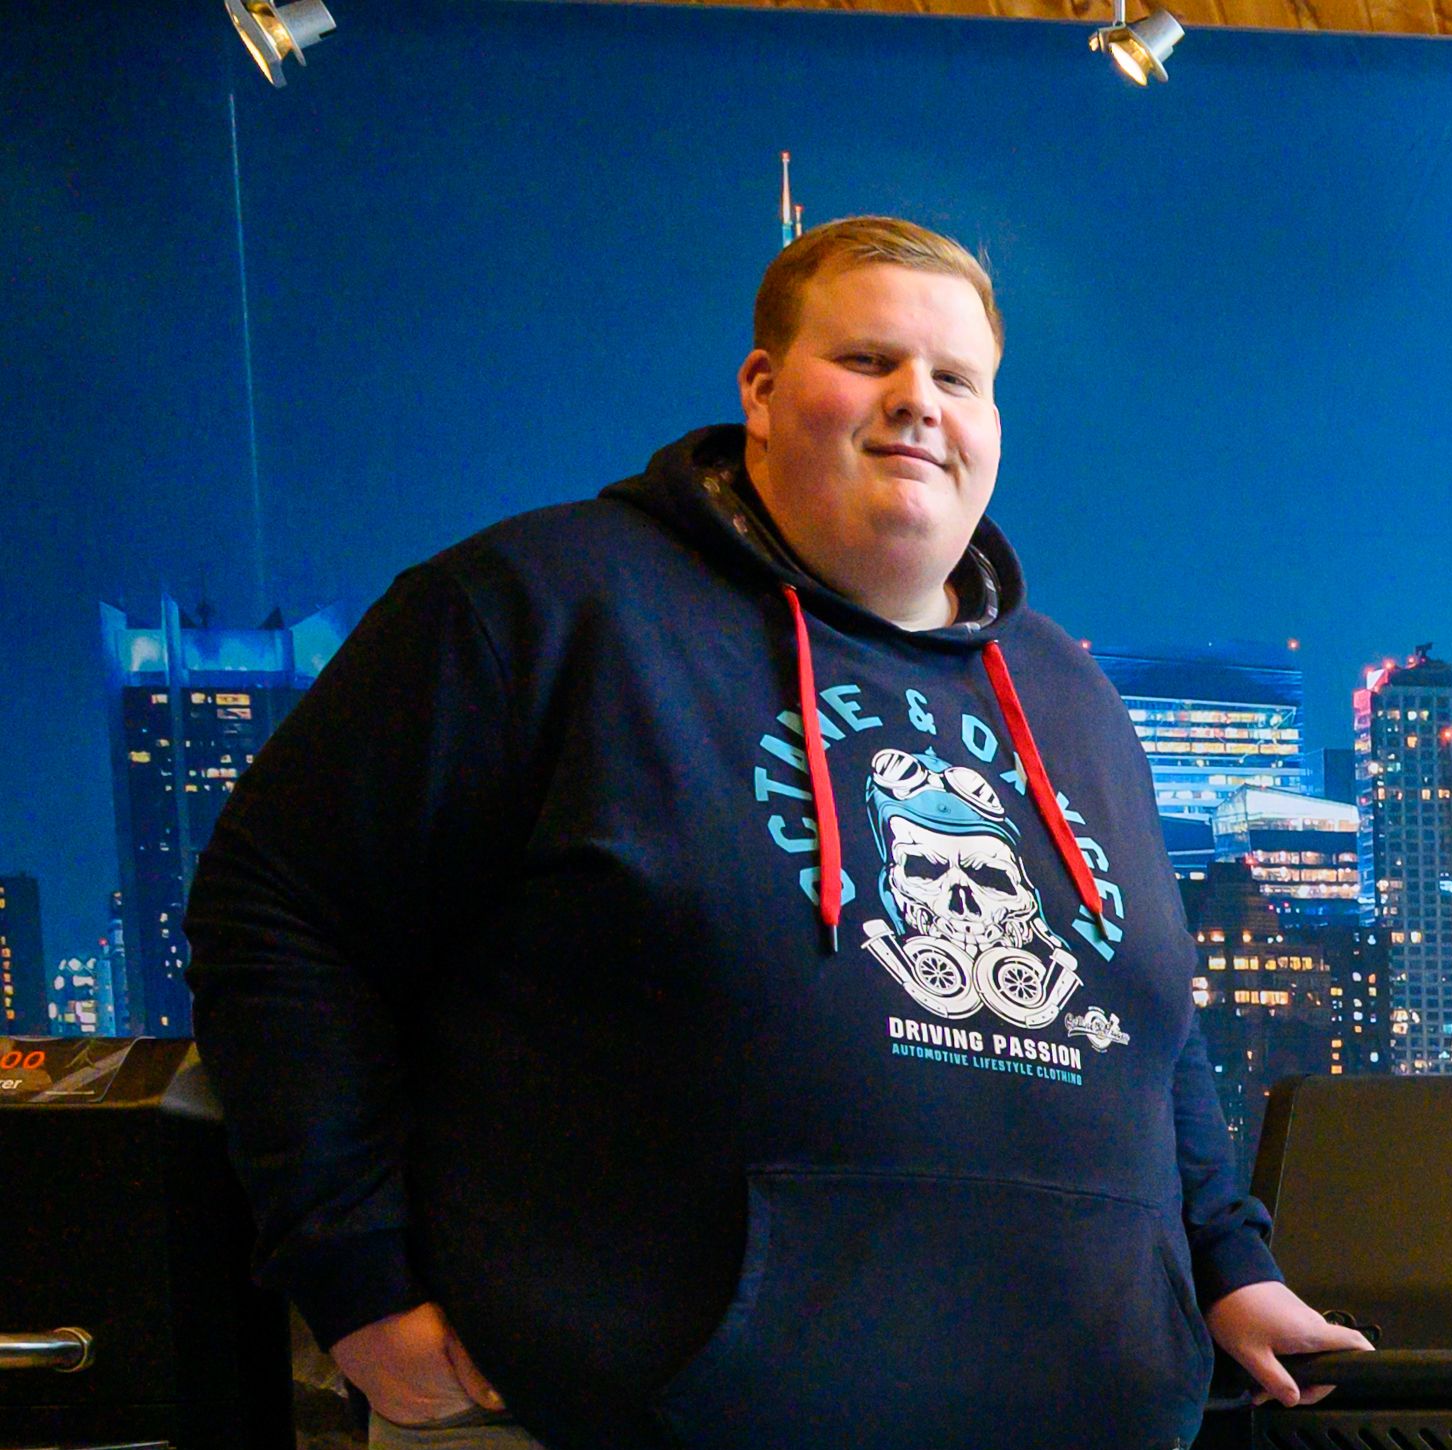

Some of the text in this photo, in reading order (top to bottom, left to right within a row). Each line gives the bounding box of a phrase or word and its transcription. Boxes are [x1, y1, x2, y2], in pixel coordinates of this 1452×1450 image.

[904, 688, 937, 736] &
[887, 1016, 1082, 1070] DRIVING PASSION
[891, 1043, 1083, 1087] AUTOMOTIVE LIFESTYLE CLOTHING
